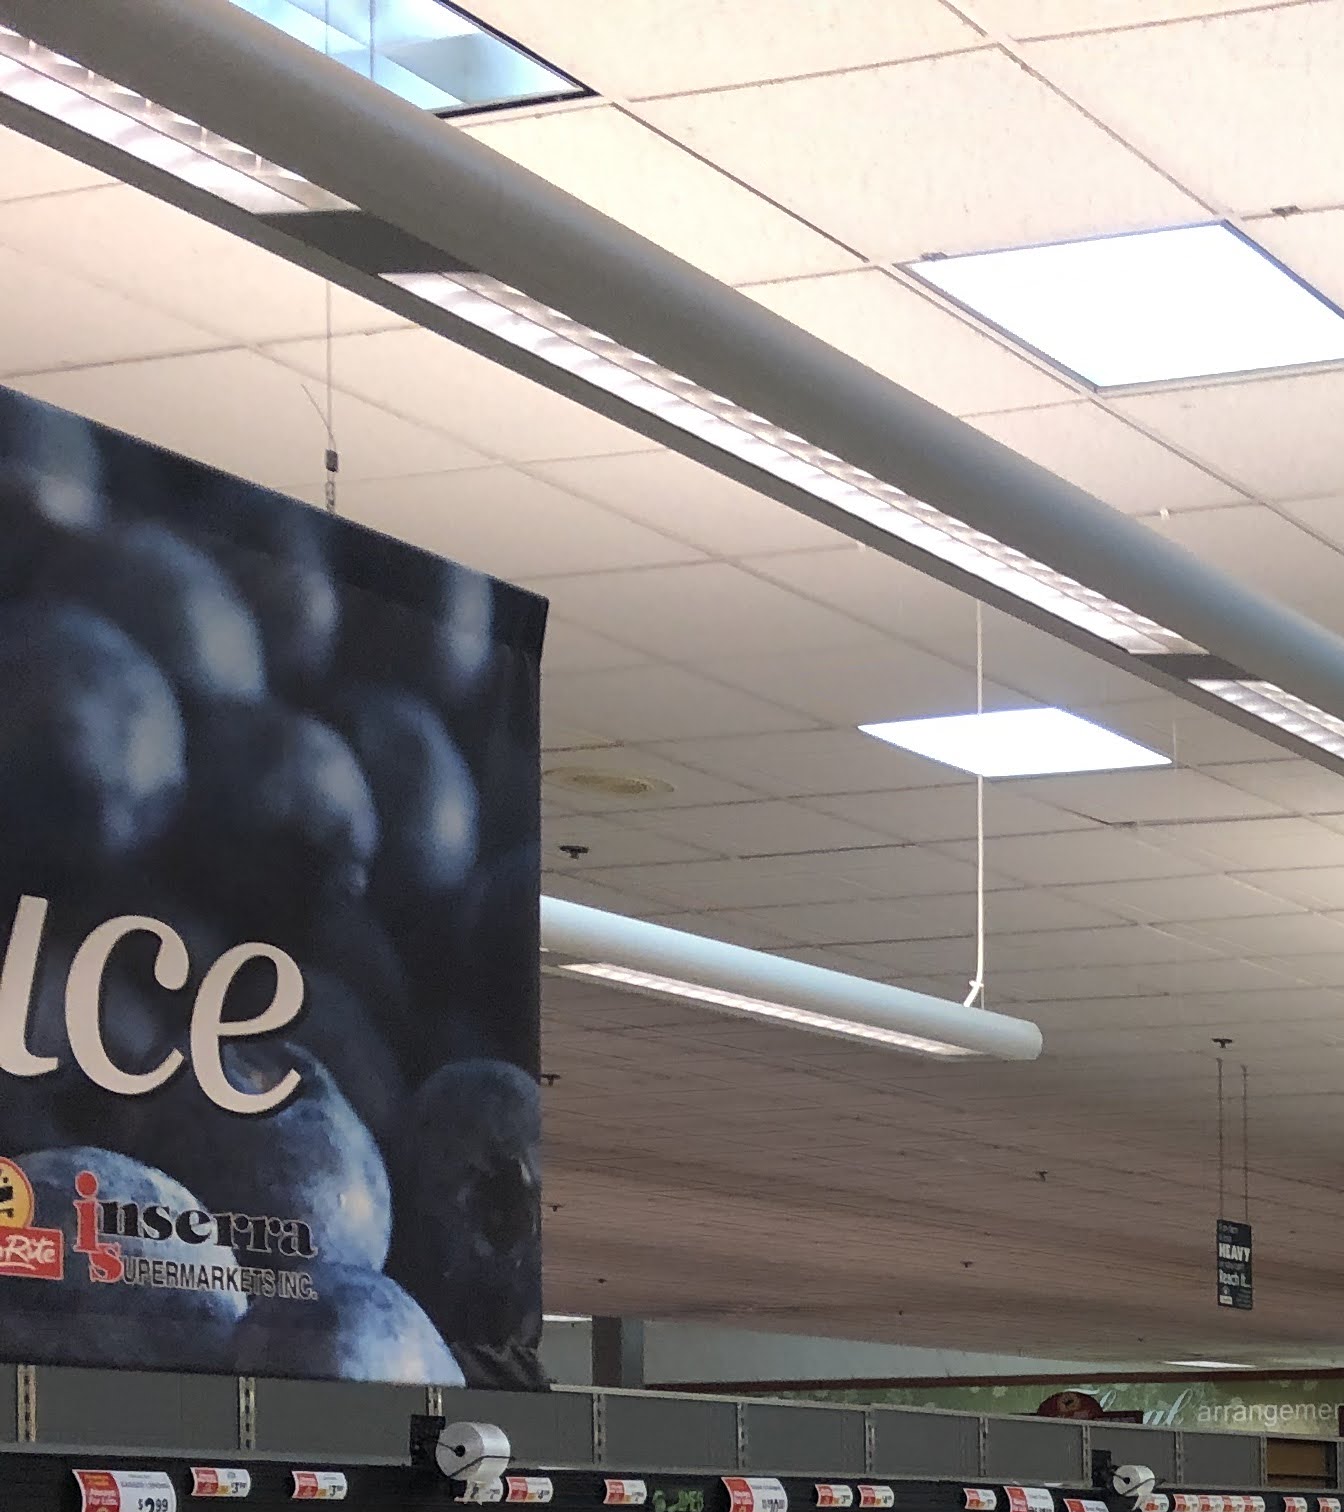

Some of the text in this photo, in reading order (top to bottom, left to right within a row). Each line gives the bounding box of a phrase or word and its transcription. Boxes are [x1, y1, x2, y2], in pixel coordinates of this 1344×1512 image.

[73, 1170, 318, 1260] inserra
[0, 1234, 57, 1272] Rite
[1219, 1242, 1250, 1262] HEAVY
[90, 1243, 319, 1301] SUPERMARKETS INC.
[1198, 1400, 1341, 1427] arrangemen
